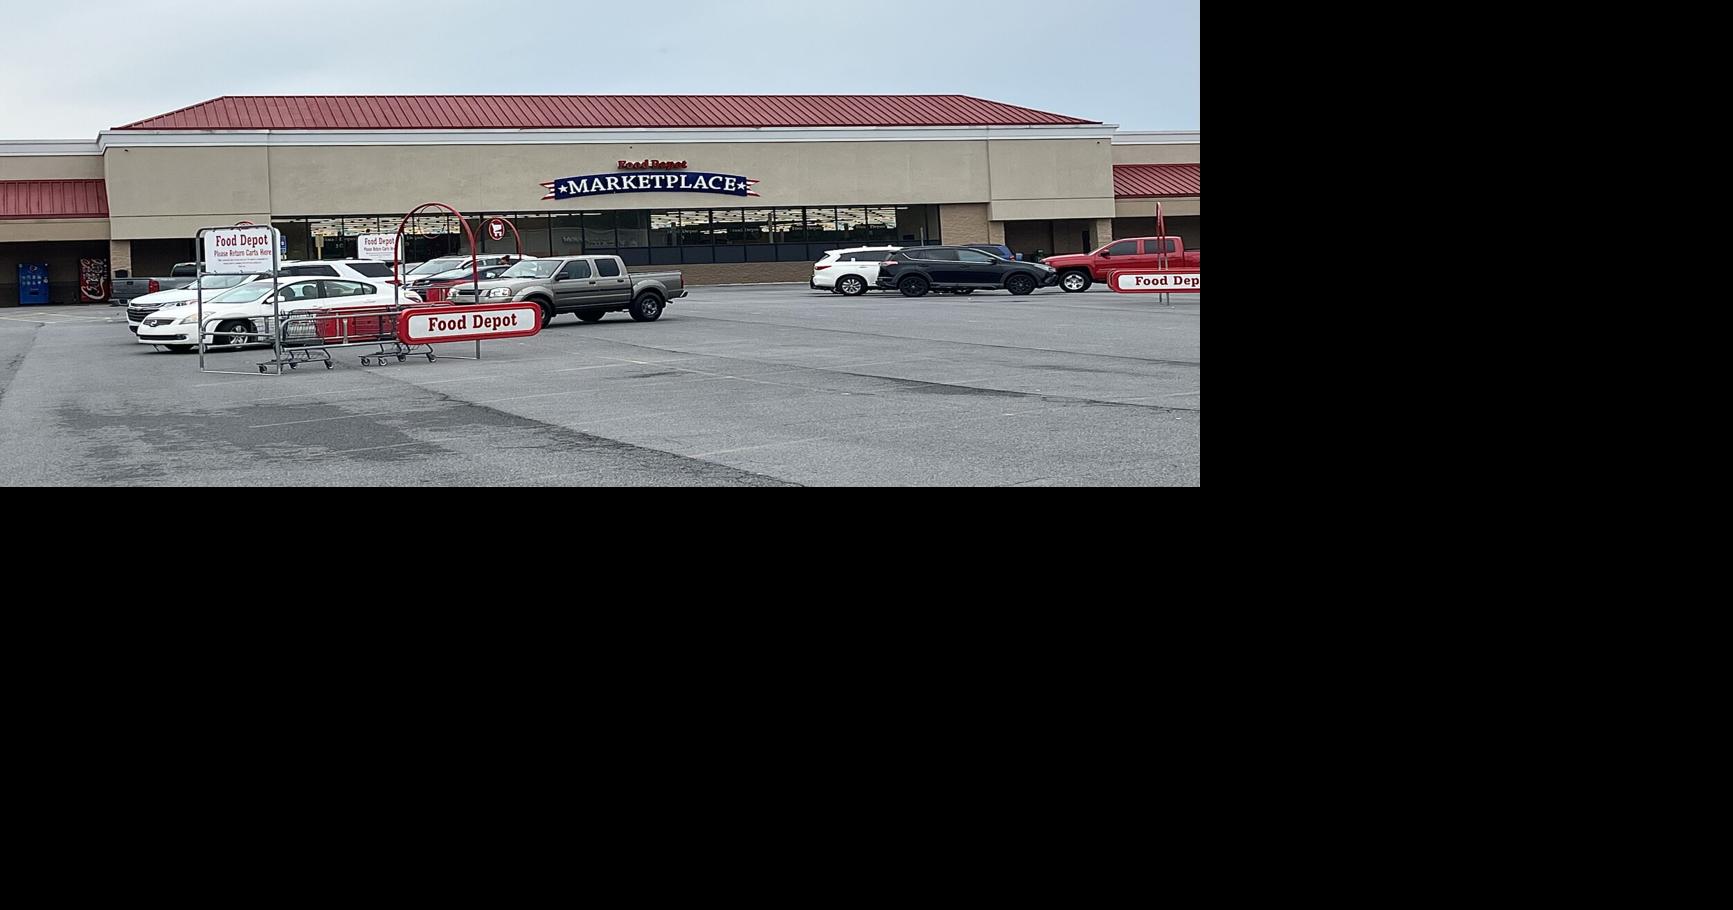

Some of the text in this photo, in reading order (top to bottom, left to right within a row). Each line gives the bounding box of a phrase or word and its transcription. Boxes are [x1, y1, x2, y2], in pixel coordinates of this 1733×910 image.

[617, 159, 688, 170] Food Depot
[567, 174, 737, 195] MARKETPLACE
[216, 235, 237, 247] Food
[240, 234, 268, 248] Depot
[229, 249, 245, 257] Return
[1135, 276, 1169, 286] Food
[428, 313, 518, 332] Food Depot
